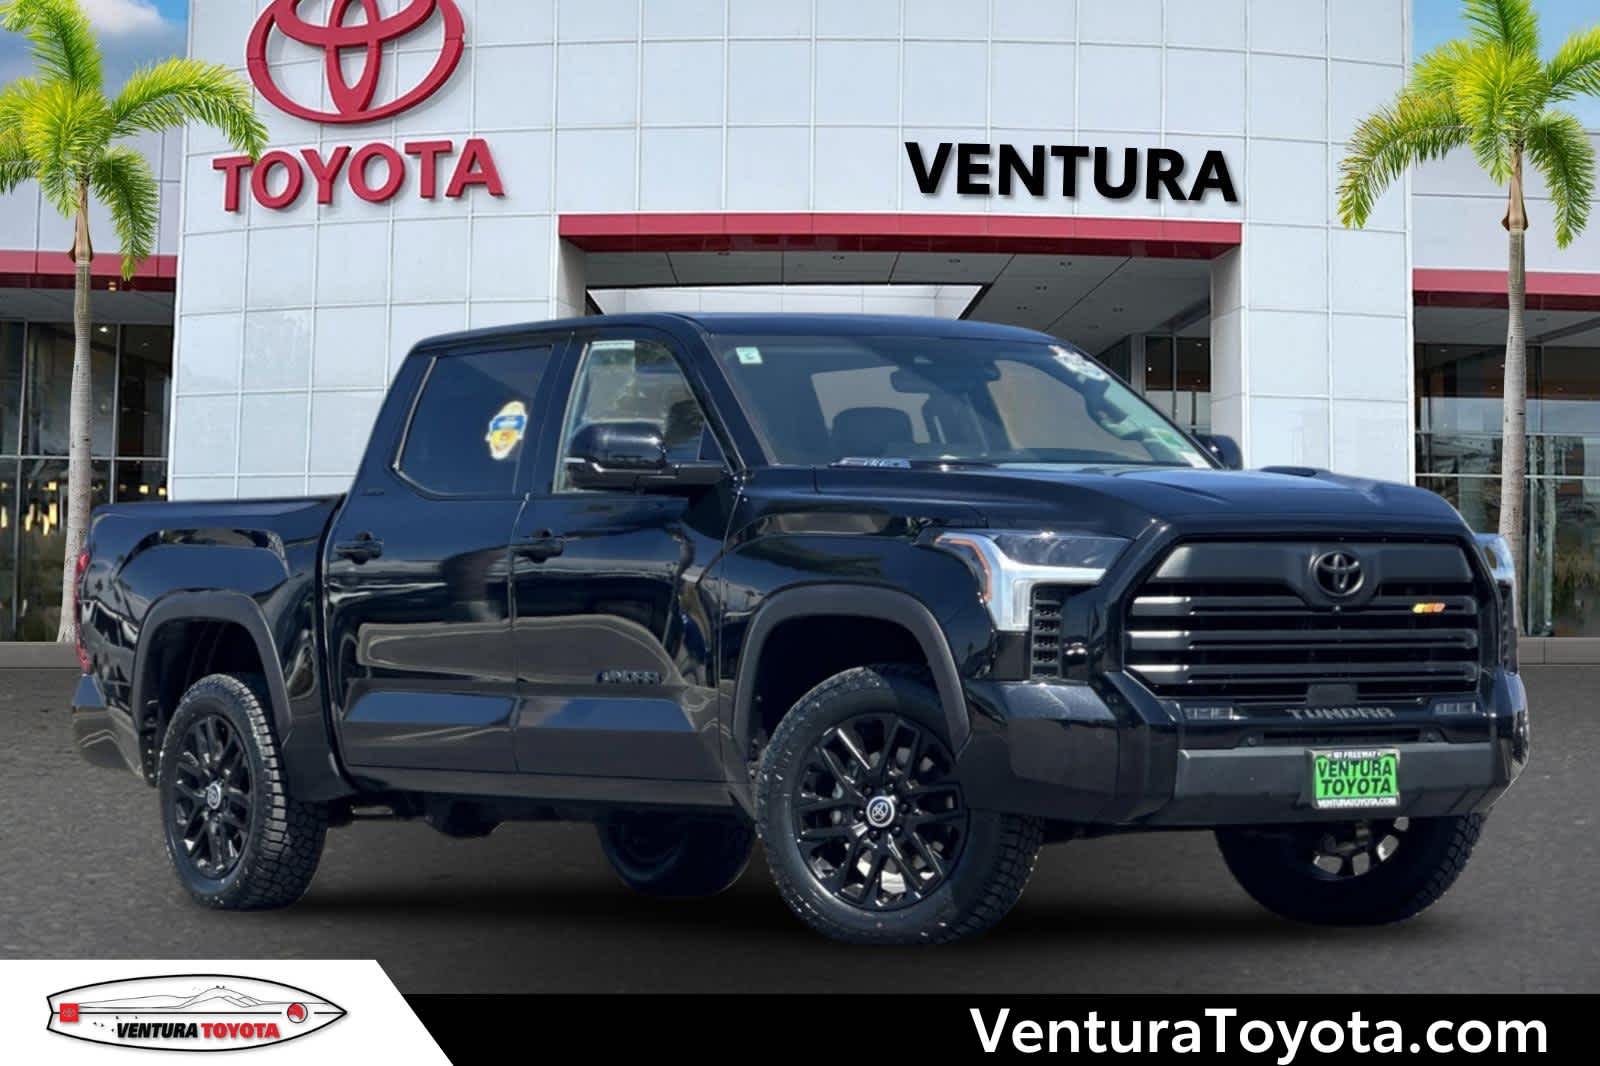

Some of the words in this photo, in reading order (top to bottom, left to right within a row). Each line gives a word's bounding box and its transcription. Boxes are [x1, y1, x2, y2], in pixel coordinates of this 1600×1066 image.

[212, 138, 505, 213] TOYOTA
[904, 141, 1239, 203] VENTURA
[1286, 707, 1396, 721] TUNDRA
[1317, 759, 1393, 778] VENTURA
[1321, 777, 1392, 796] TOYOTA
[1317, 797, 1397, 808] VENTURATOYOTA.COM
